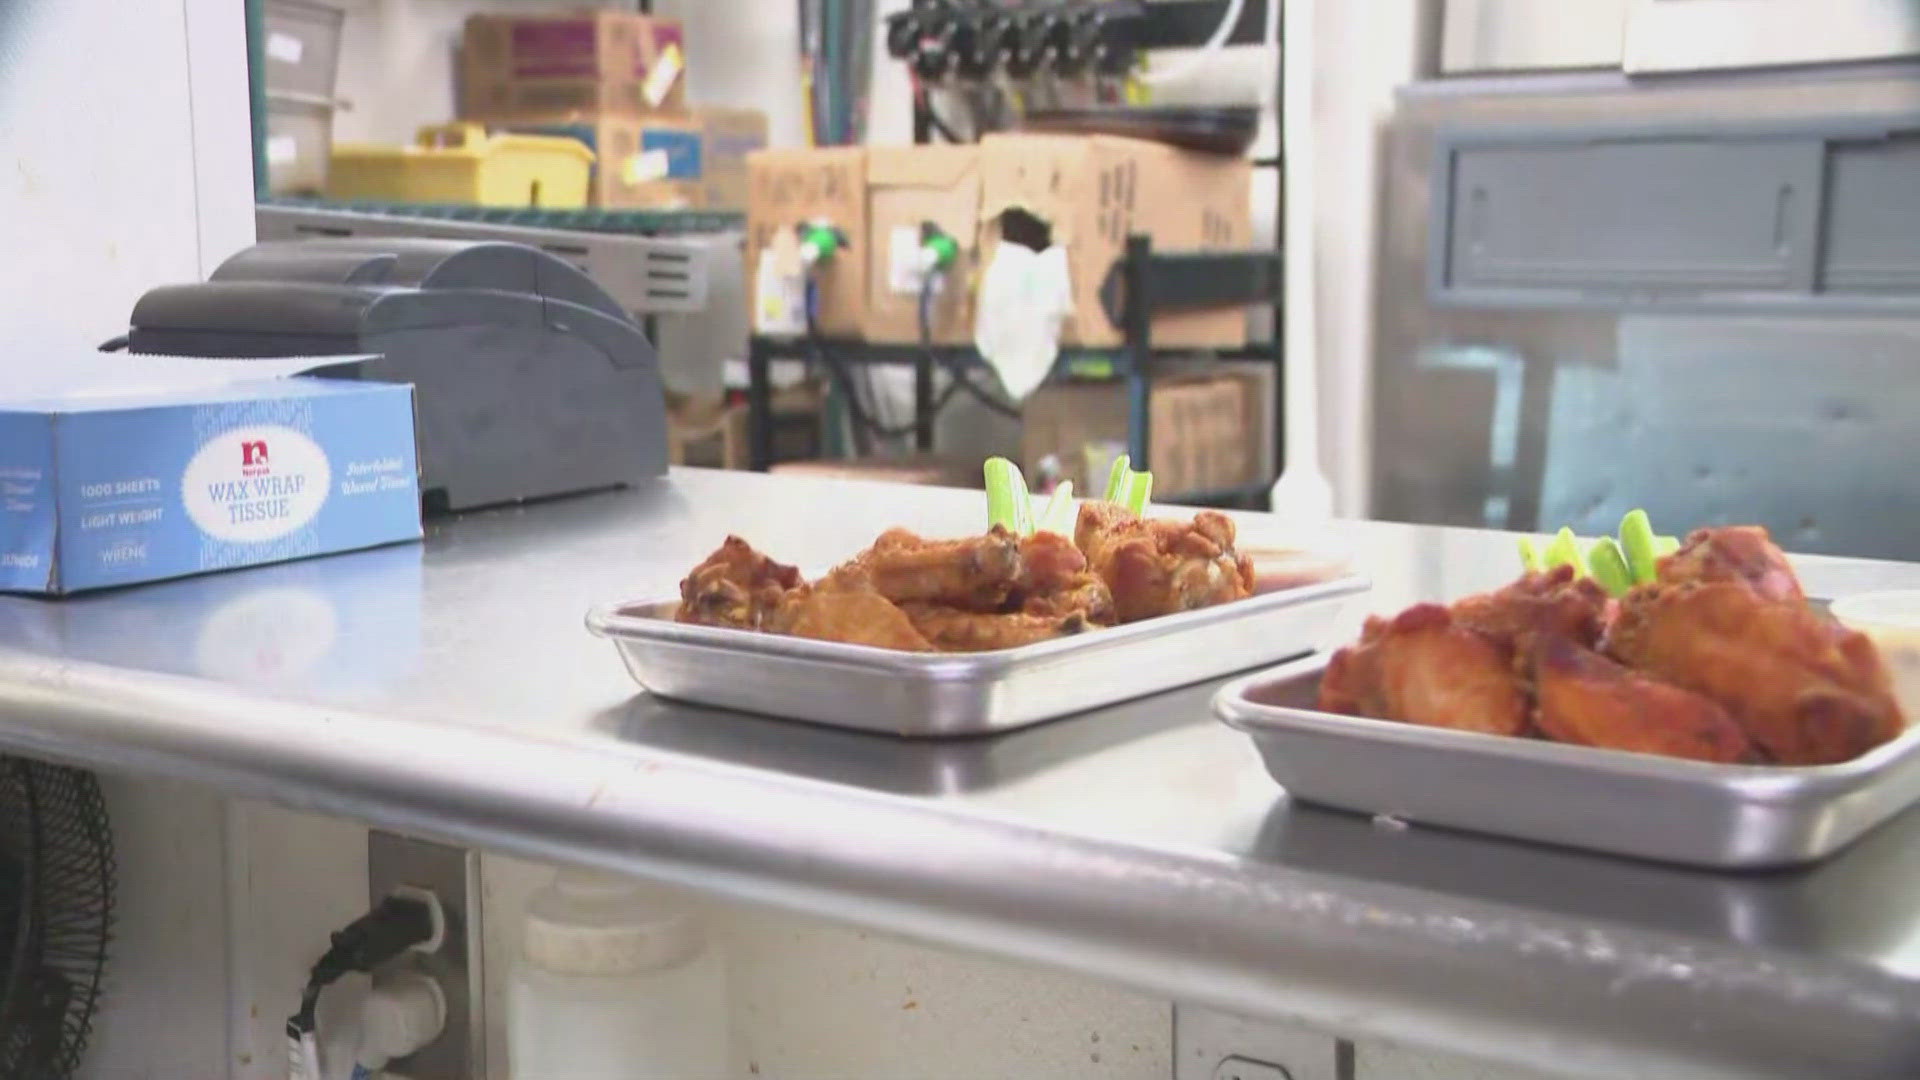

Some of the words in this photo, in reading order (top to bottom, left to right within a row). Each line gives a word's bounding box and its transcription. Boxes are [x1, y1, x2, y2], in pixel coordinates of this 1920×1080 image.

[81, 483, 112, 497] 1000
[115, 479, 161, 495] SHEETS
[208, 479, 249, 502] WAX
[253, 474, 305, 497] WRAP
[81, 513, 115, 529] LIGHT
[117, 507, 163, 525] WEIGHT
[228, 499, 289, 524] TISSUE
